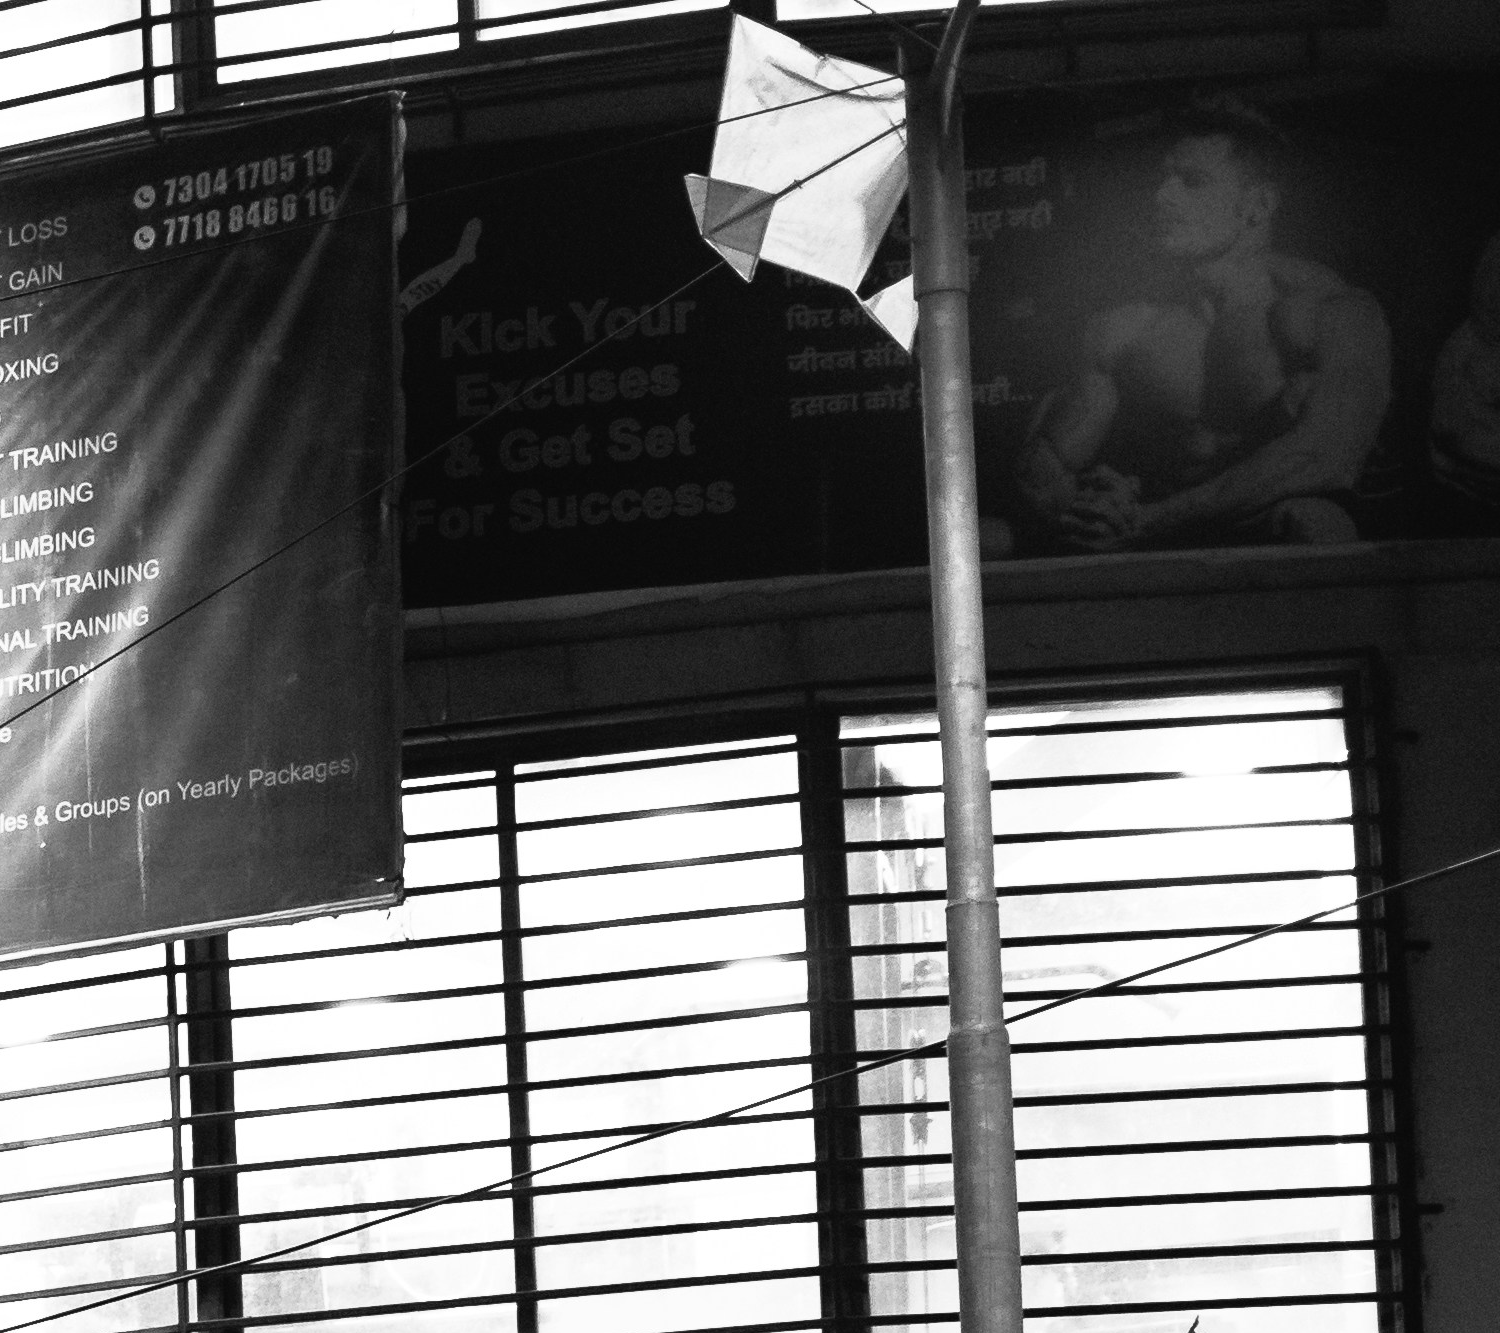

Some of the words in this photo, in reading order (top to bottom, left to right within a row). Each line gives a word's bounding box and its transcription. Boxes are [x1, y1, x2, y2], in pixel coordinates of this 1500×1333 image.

[163, 166, 228, 207] 7304
[236, 152, 296, 192] 1705
[304, 145, 334, 177] 19
[8, 217, 68, 247] LOSS
[163, 207, 221, 248] 7718
[8, 261, 64, 291] GAIN
[0, 312, 33, 339] FIT
[569, 297, 697, 344] Your
[455, 363, 681, 418] Excuses
[9, 431, 119, 474] TRAINING
[500, 423, 592, 473] Get
[607, 413, 697, 462] Set
[405, 498, 494, 542] For
[508, 480, 736, 533] Success
[51, 558, 161, 601] TRAINING
[42, 606, 150, 646] TRAINING
[34, 805, 49, 827] &
[54, 795, 131, 826] Groups
[137, 787, 170, 813] (on
[176, 773, 243, 803] Yearly
[248, 752, 360, 789] Packages)
